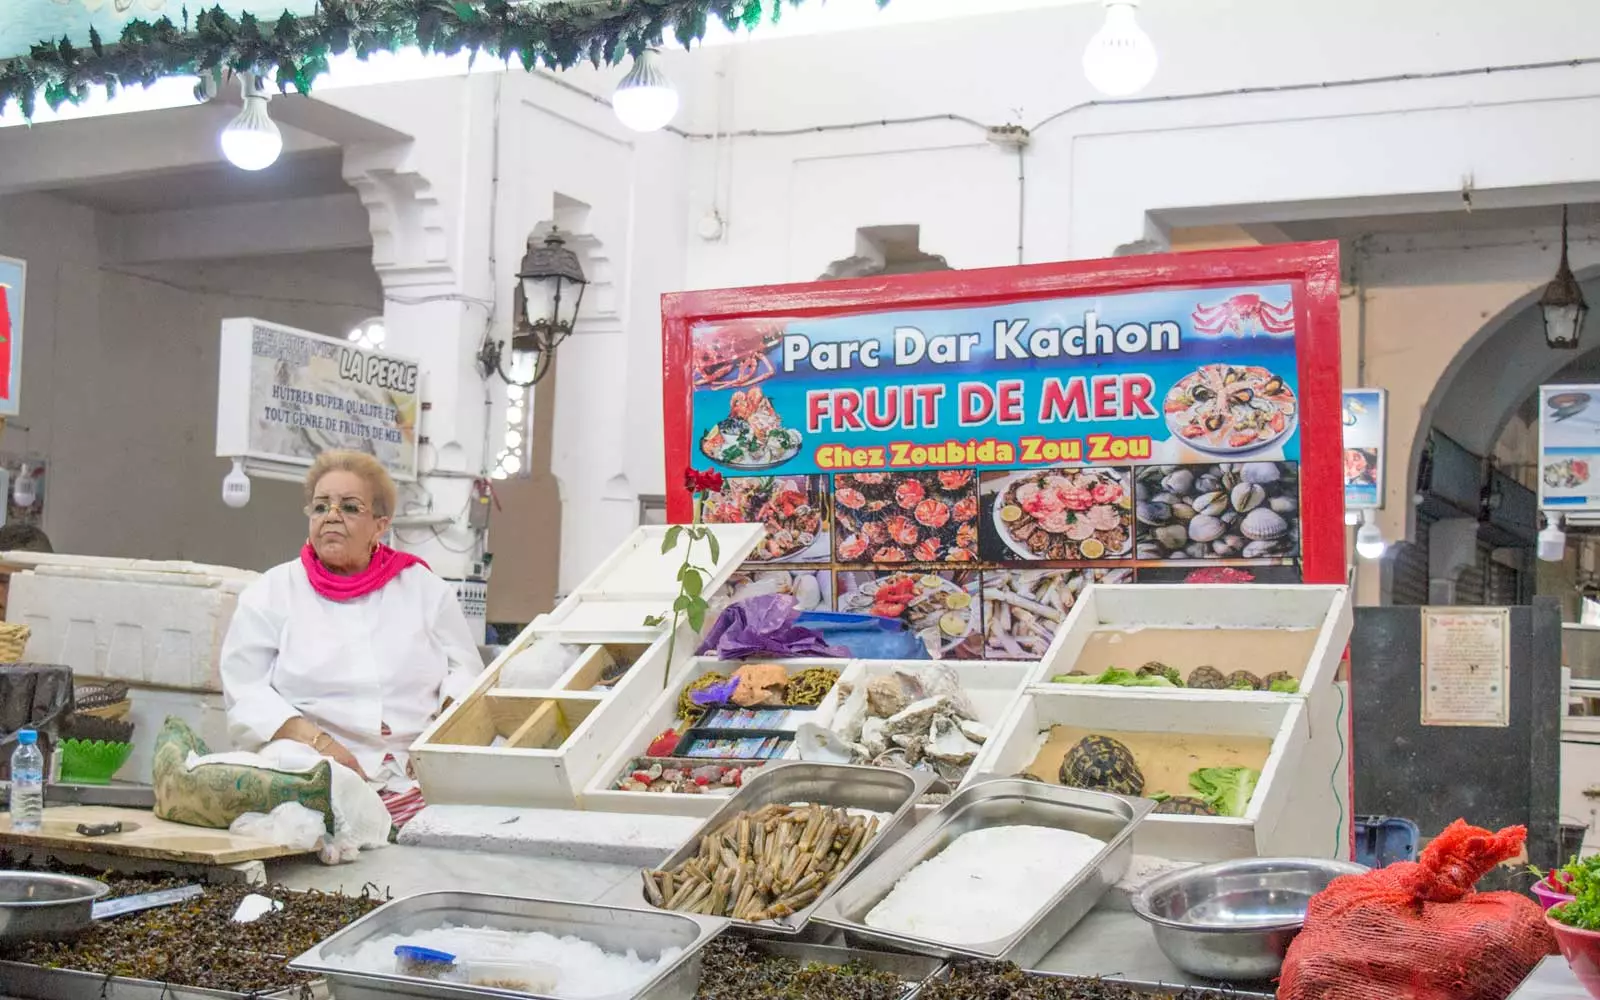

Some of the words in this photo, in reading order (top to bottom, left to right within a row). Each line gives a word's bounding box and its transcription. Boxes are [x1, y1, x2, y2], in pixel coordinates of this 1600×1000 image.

[783, 333, 880, 373] Parc
[893, 325, 981, 367] Dar
[993, 310, 1181, 360] Kachon
[340, 348, 364, 384] LA
[366, 355, 418, 394] PERLE
[315, 392, 345, 411] SUPER
[385, 407, 396, 421] ET
[806, 383, 945, 433] FRUIT
[958, 379, 1024, 427] DE
[1038, 373, 1159, 424] MER
[264, 406, 291, 424] TOUT
[292, 412, 324, 430] GENRE
[325, 416, 338, 432] DE
[339, 419, 371, 438] FRUITS
[372, 426, 384, 441] DE
[385, 427, 403, 443] MER
[815, 443, 886, 469] Chez
[889, 438, 1016, 467] Zoubida
[1020, 436, 1083, 464] Zou
[1087, 433, 1152, 460] Zou
